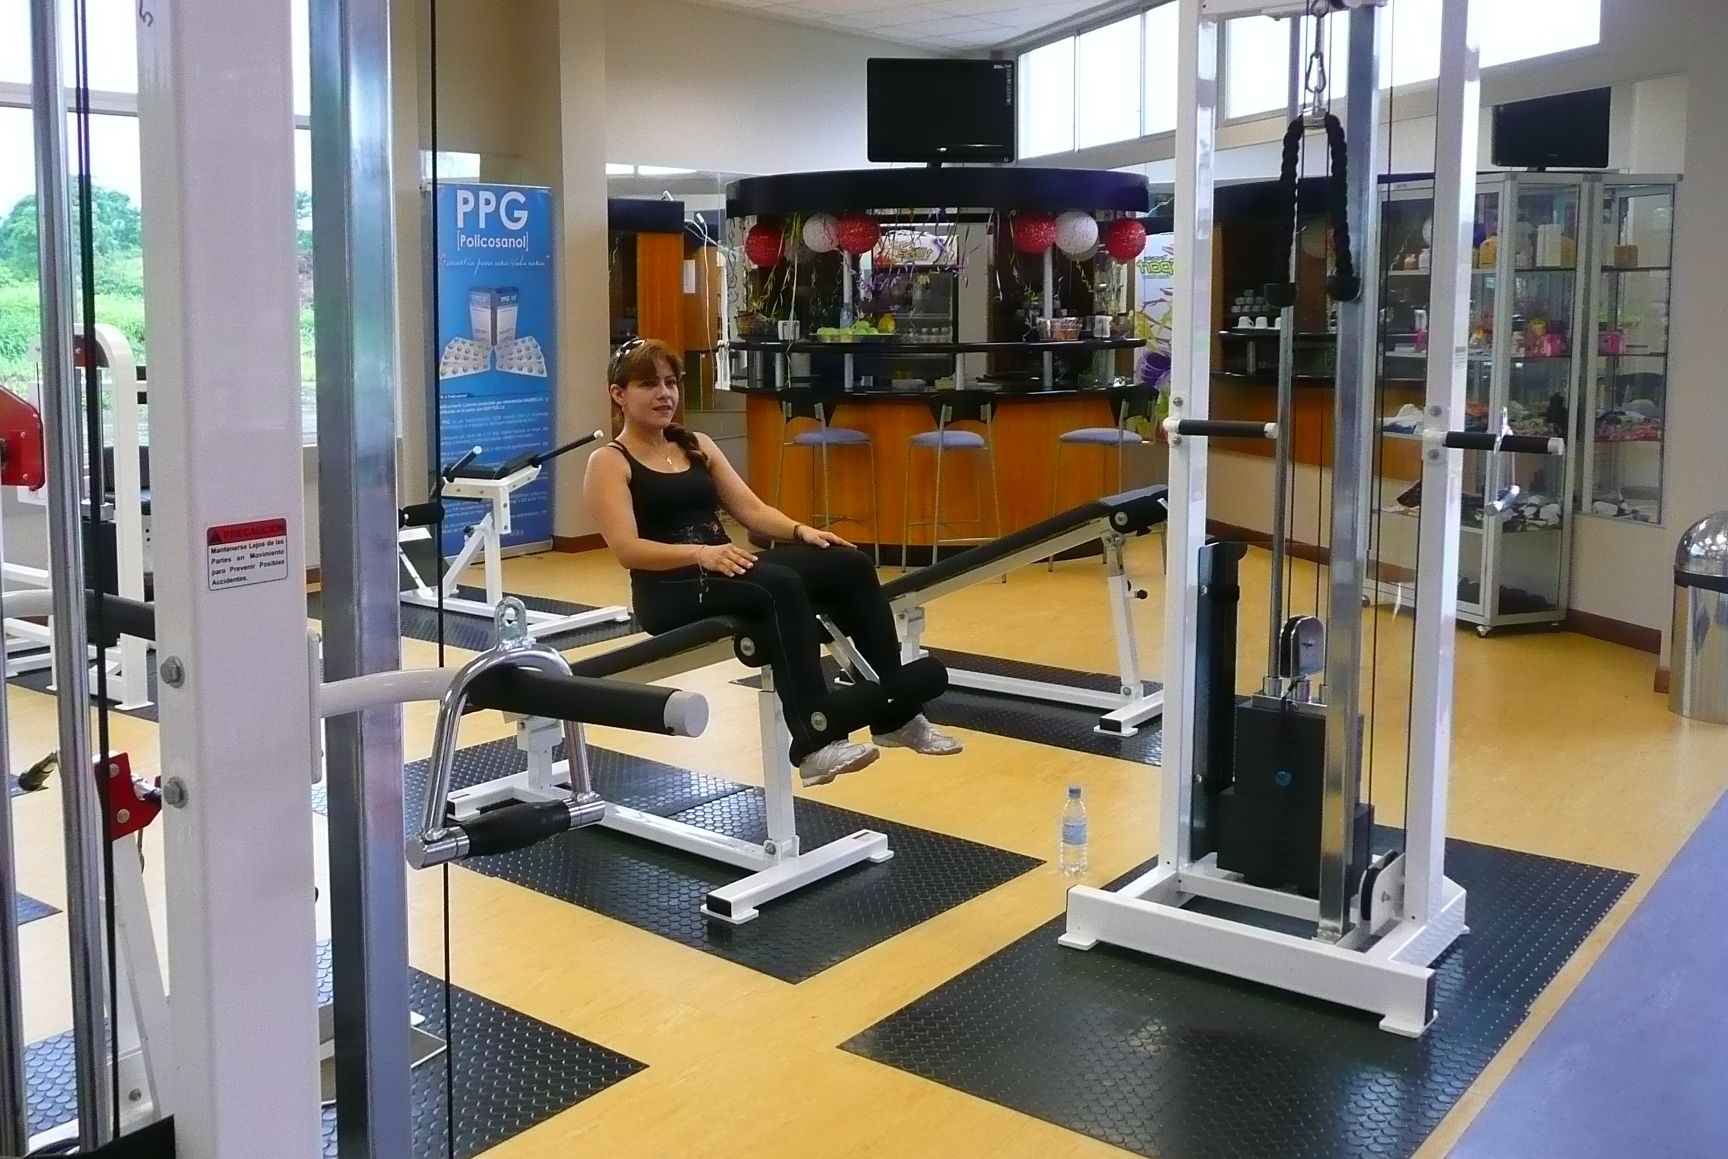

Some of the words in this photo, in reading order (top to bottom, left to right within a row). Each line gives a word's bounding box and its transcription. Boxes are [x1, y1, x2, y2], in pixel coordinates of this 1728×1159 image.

[456, 189, 529, 231] PPG
[211, 544, 247, 554] Mantenerse
[248, 541, 266, 550] Lejos
[250, 550, 285, 558] Movimiento
[212, 568, 226, 576] para
[230, 564, 256, 573] Prevenir
[259, 560, 285, 568] Posibles
